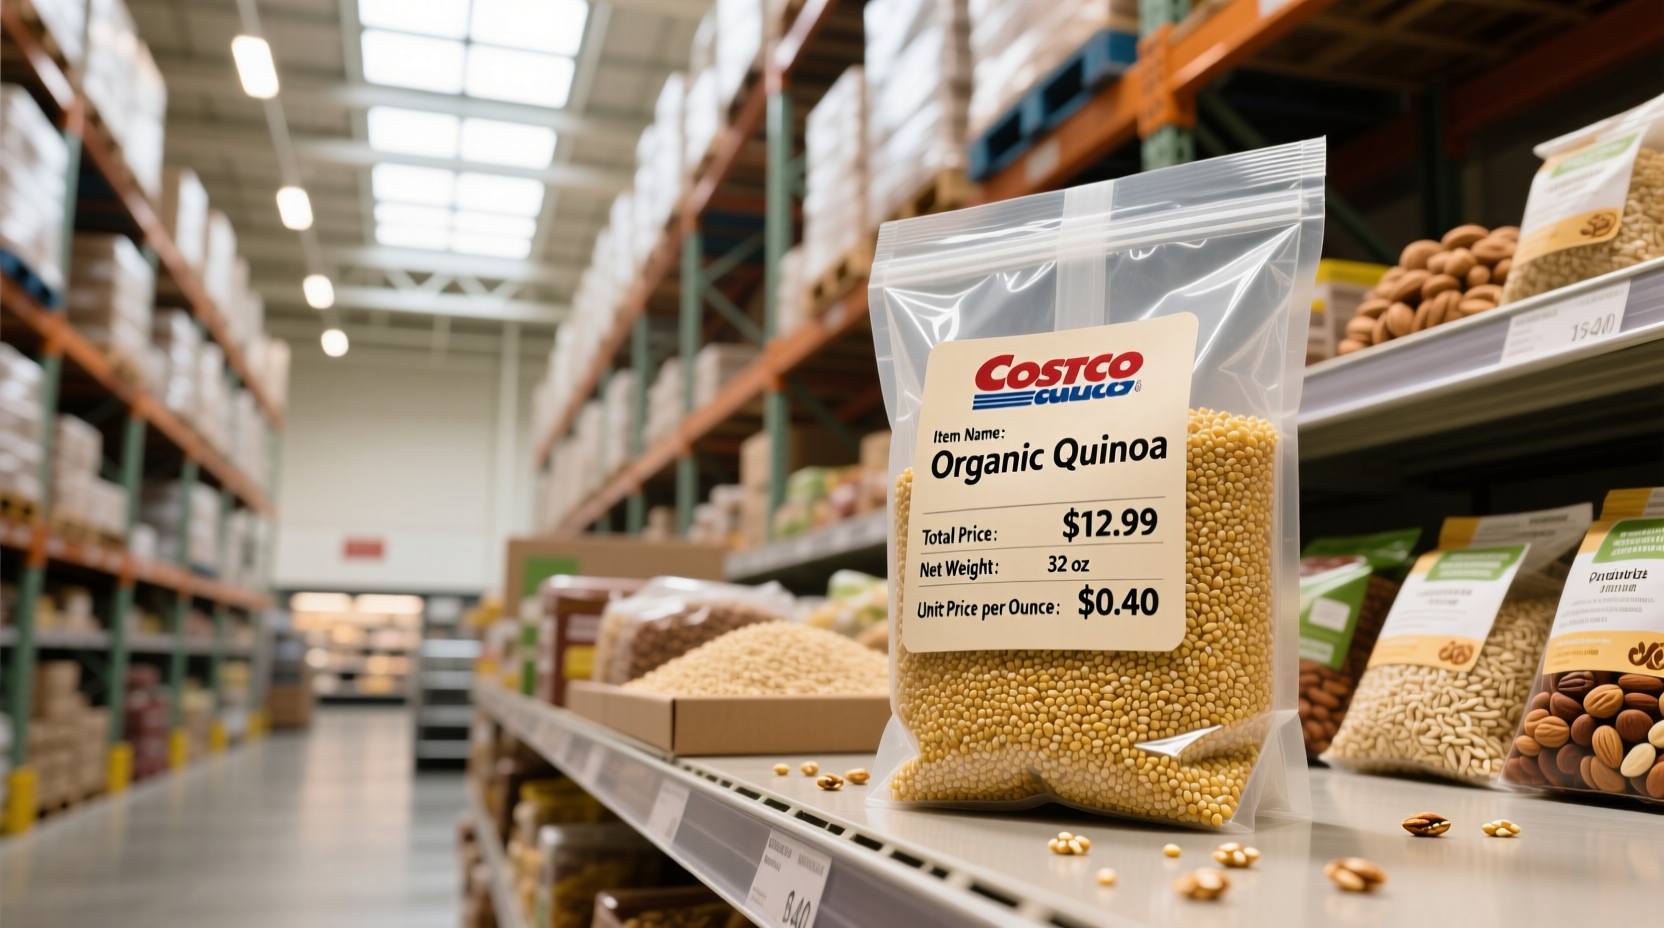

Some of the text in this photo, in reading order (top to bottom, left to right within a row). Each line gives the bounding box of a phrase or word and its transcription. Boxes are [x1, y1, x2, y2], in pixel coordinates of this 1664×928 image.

[933, 427, 1006, 444] Item Name:
[931, 433, 1168, 486] Organic Quinoa
[922, 507, 1159, 546] Total Price: $12.99
[919, 554, 1090, 581] Net Weight: 32 oz
[917, 583, 1160, 621] Unit Price per Ounce: $0.40
